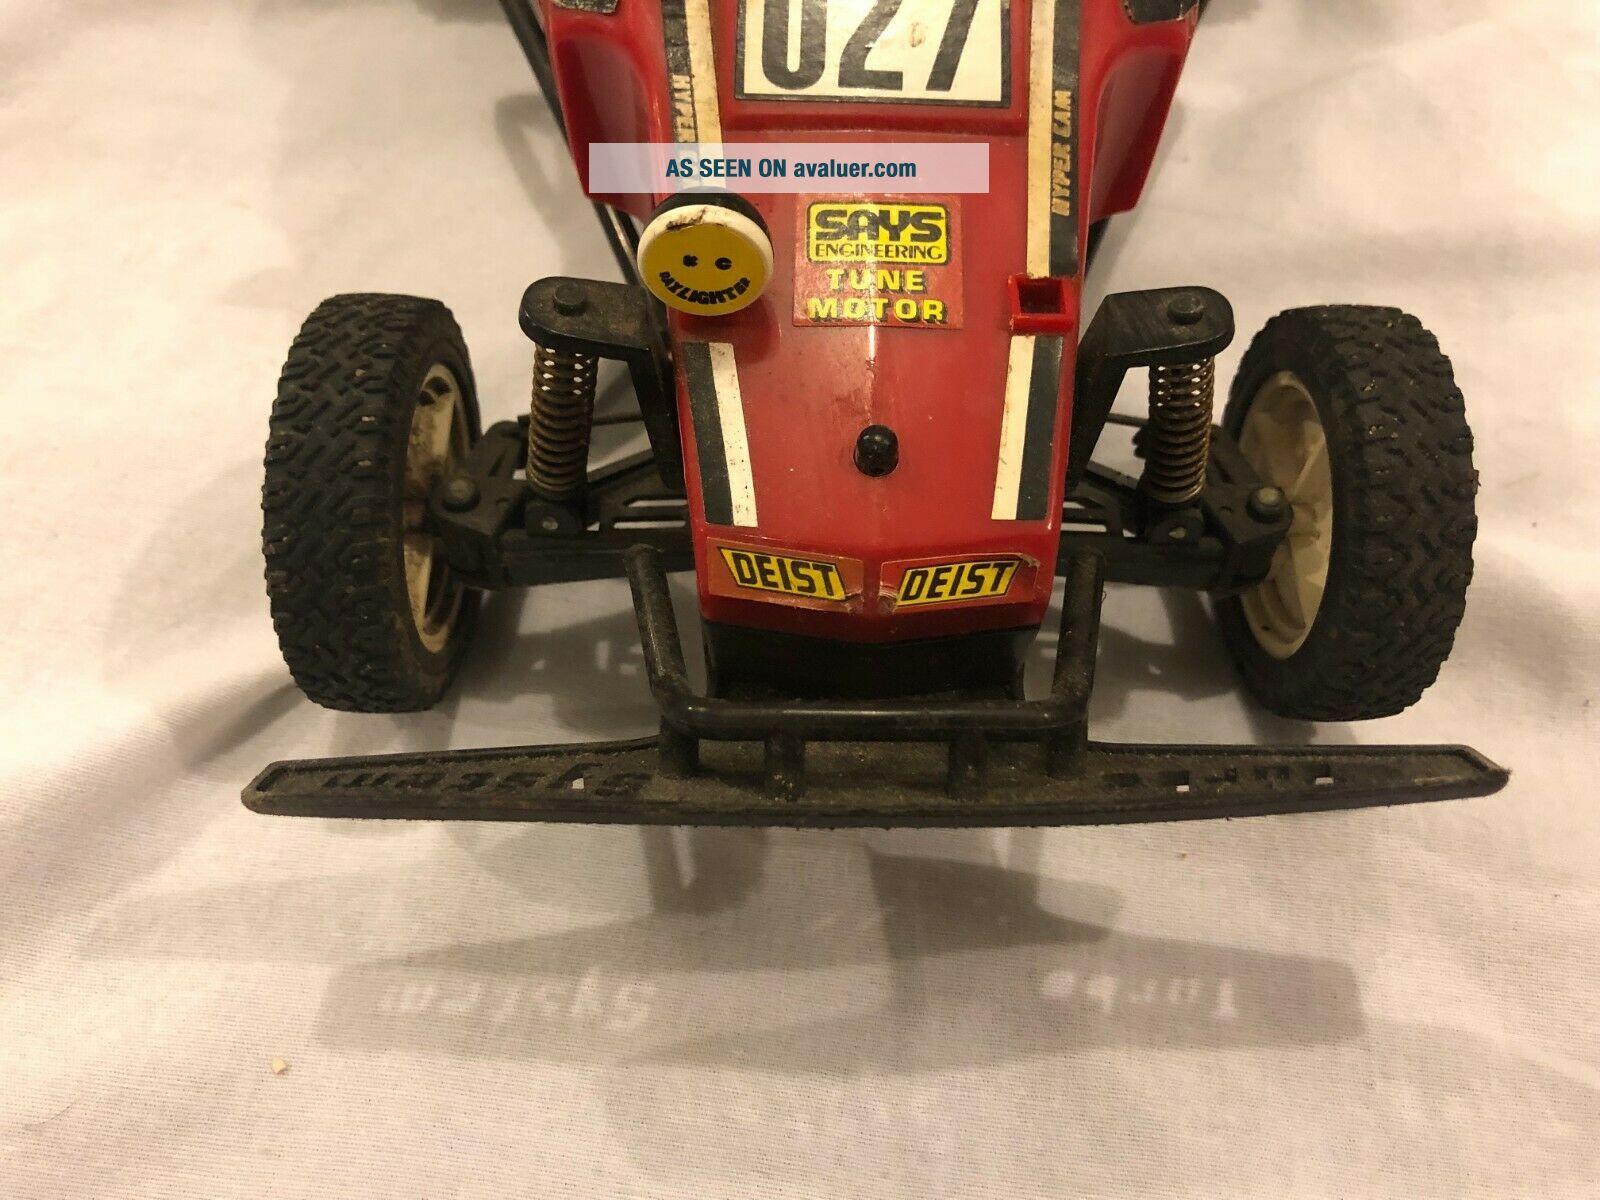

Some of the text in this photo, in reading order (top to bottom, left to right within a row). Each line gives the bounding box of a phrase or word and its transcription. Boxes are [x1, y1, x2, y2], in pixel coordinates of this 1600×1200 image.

[1051, 89, 1072, 217] HYPER CAM
[815, 209, 944, 243] SAYS
[815, 243, 943, 260] ENGINEERING
[826, 268, 927, 294] TUNE
[806, 297, 947, 324] MOTOR
[731, 552, 836, 597] DEIST
[901, 561, 1016, 602] DEIST
